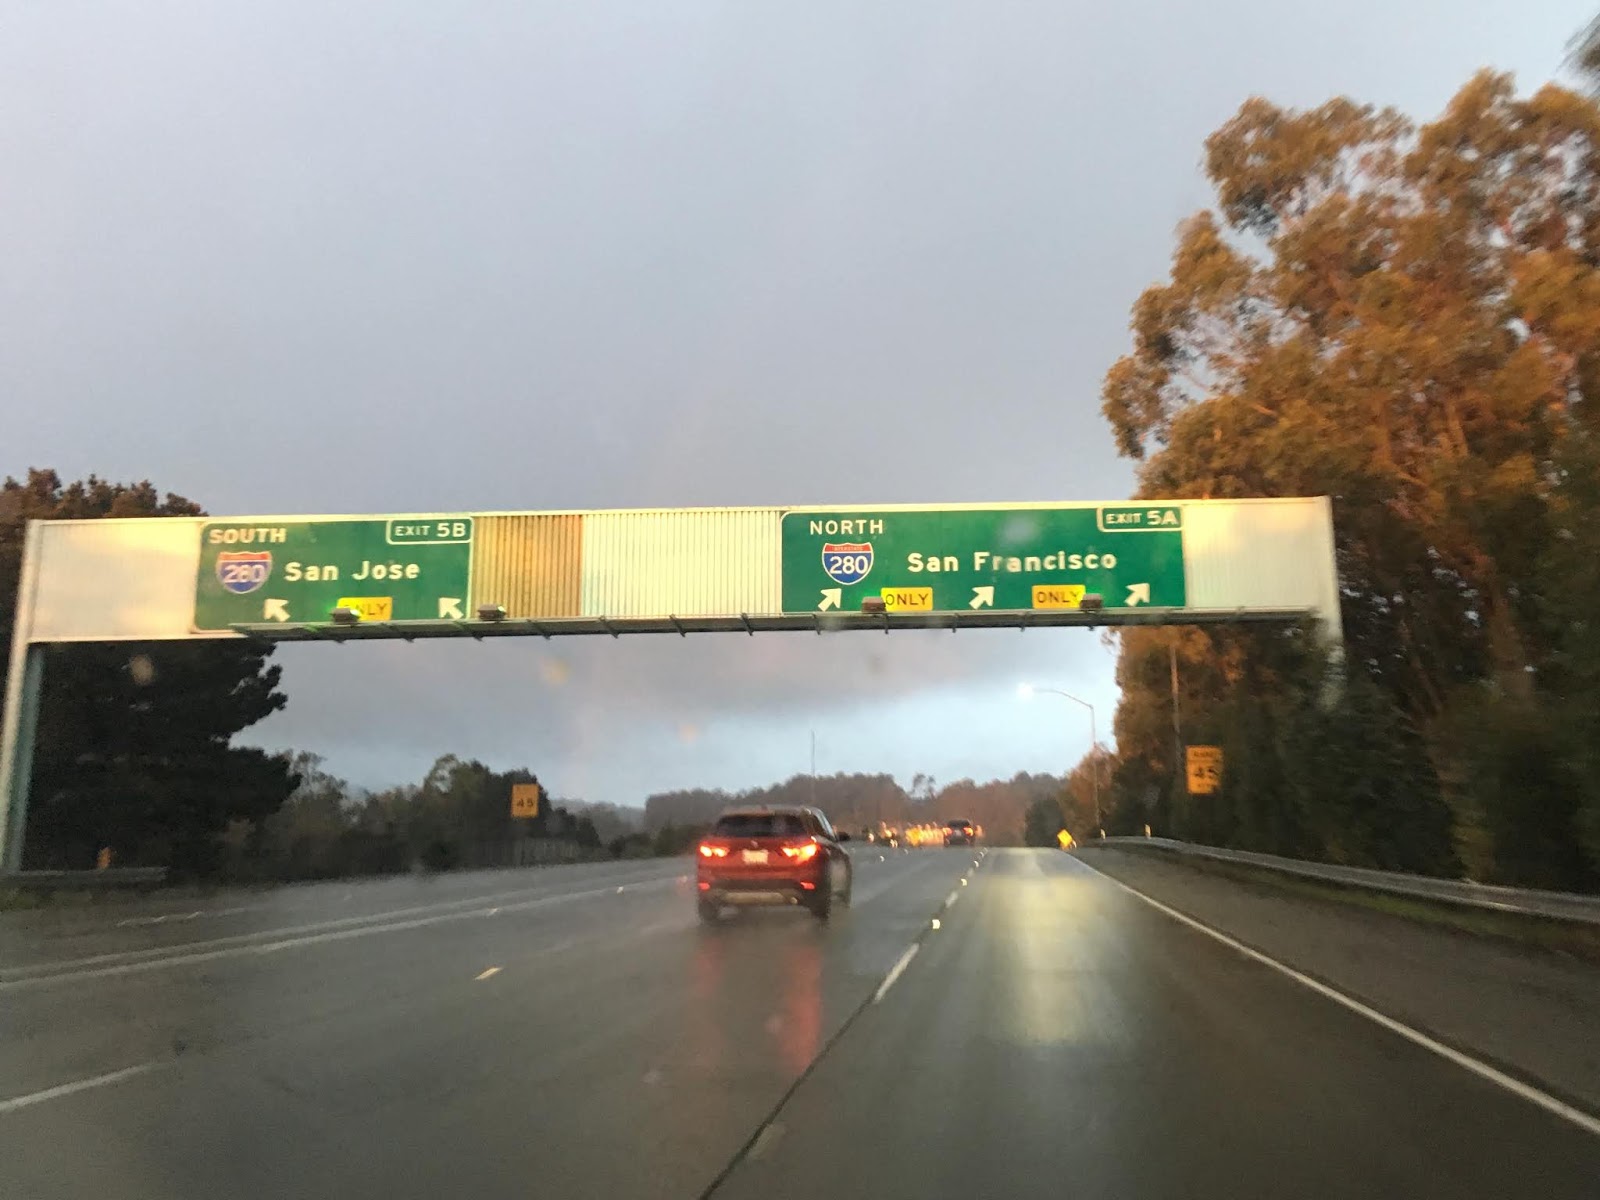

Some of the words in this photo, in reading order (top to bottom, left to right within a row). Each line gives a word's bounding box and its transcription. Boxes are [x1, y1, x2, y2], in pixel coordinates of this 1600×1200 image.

[1104, 513, 1142, 525] EXIT
[1146, 510, 1179, 526] 5A
[209, 526, 287, 545] SOUTH
[394, 525, 431, 538] EXIT
[436, 522, 467, 539] 5B
[809, 519, 884, 536] NORTH
[283, 561, 339, 582] San
[351, 559, 421, 581] Jose
[830, 555, 869, 575] 280
[907, 552, 960, 574] San
[973, 551, 1118, 573] Francisco
[224, 564, 265, 584] 280
[885, 593, 929, 606] ONLY
[1036, 590, 1081, 604] ONLY
[343, 603, 388, 616] NLY
